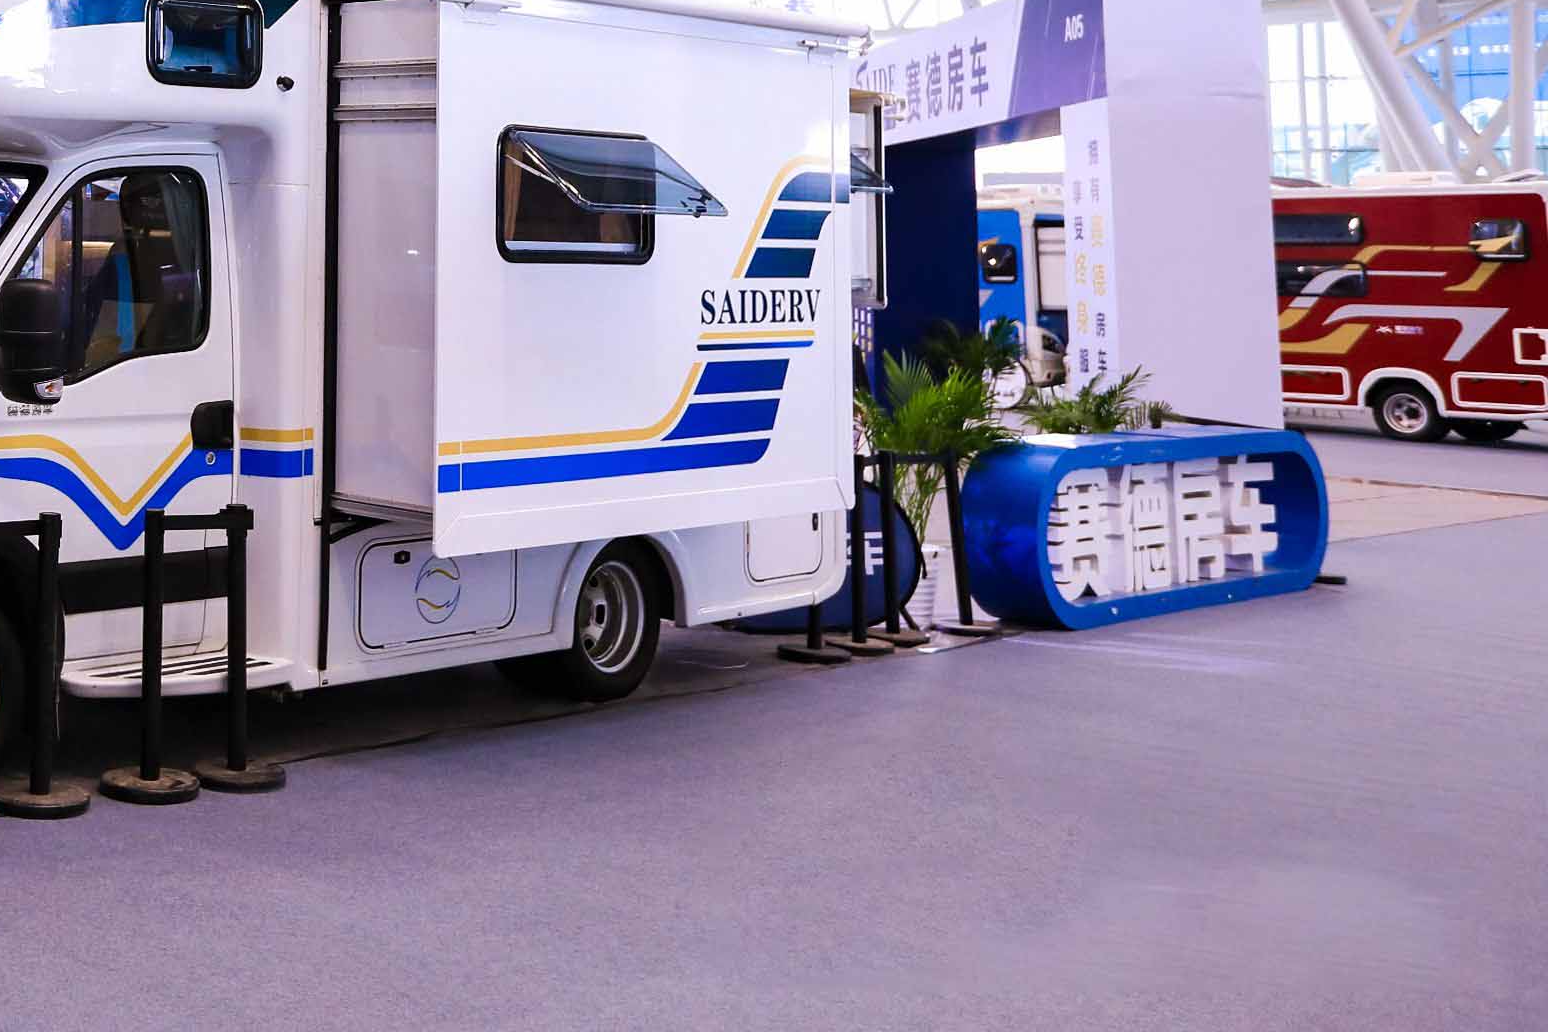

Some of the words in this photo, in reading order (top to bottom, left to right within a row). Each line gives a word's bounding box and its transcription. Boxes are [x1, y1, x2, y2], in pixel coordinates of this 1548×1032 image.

[906, 34, 989, 124] 赛德房车
[700, 288, 821, 325] SAIDERV
[1046, 454, 1279, 602] 赛德房车
